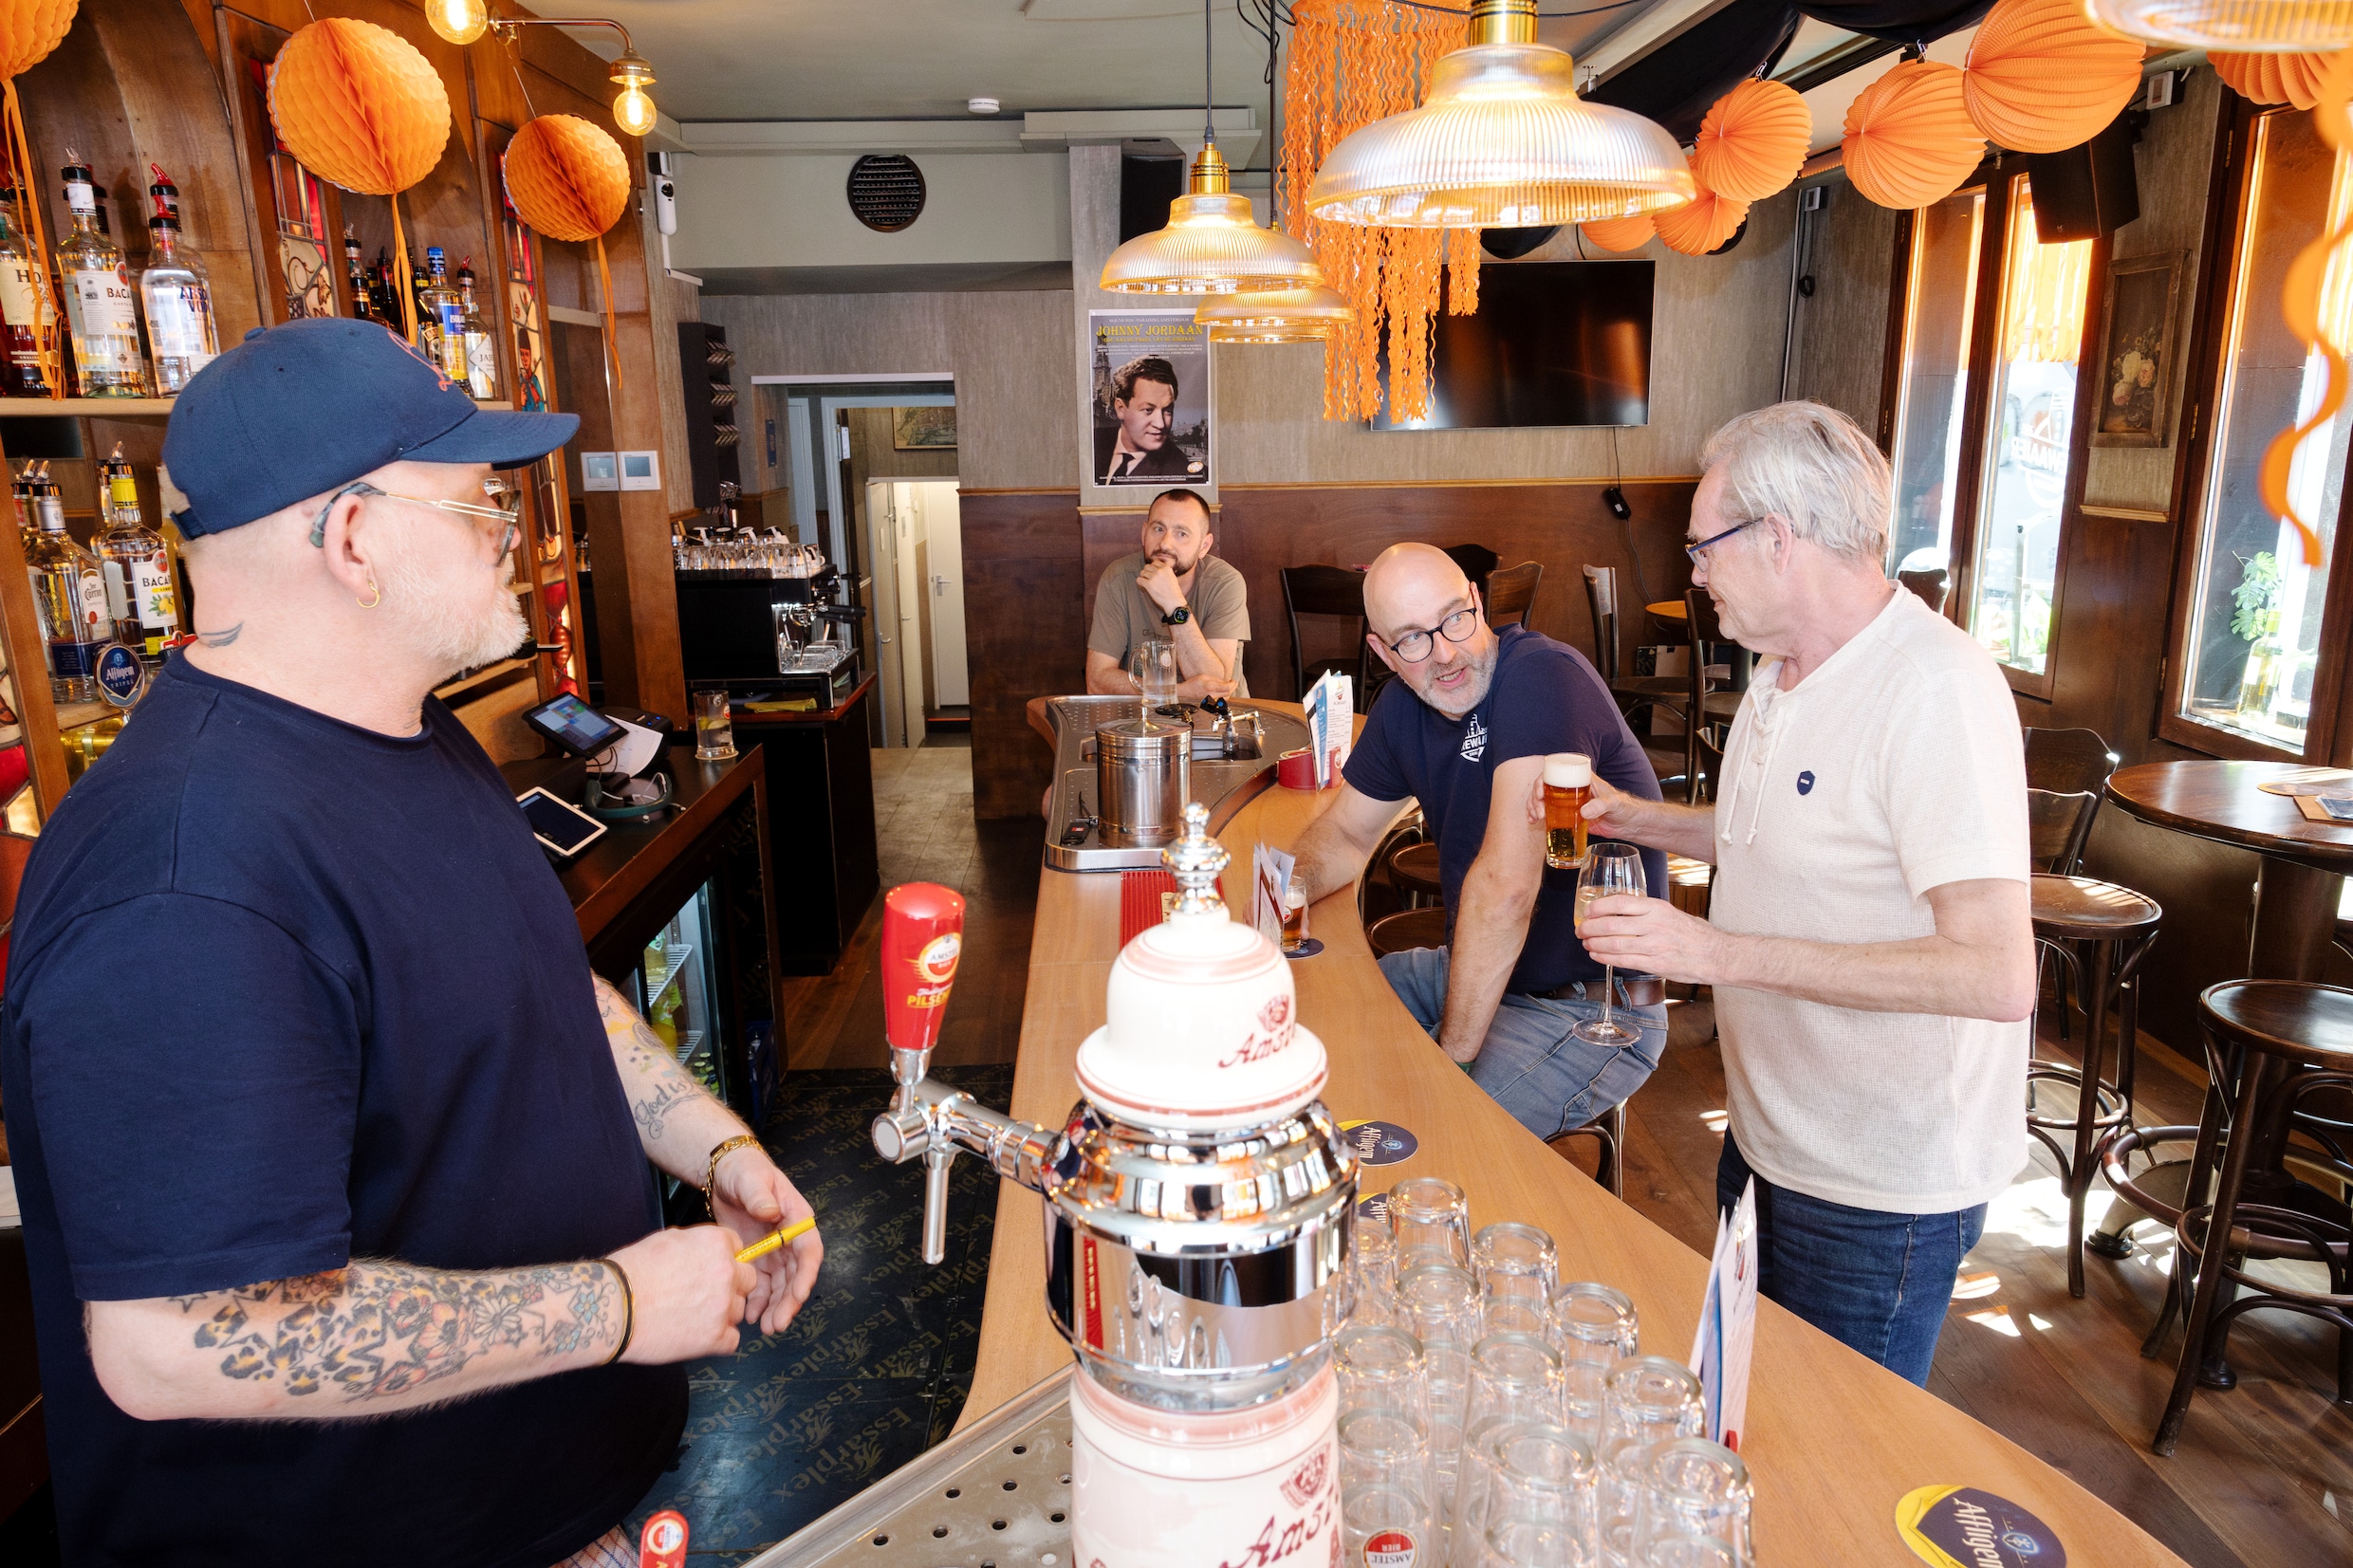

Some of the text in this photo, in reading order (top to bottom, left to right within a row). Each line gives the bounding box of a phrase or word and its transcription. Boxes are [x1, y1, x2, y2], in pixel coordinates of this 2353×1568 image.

[106, 287, 131, 299] BACA
[179, 286, 207, 300] ABSO
[1096, 323, 1203, 337] JOHNNY JORDAAN
[142, 577, 171, 587] BACA
[105, 666, 135, 681] Affligem
[110, 680, 135, 689] TRIPEL
[1356, 1126, 1381, 1159] Affligem
[734, 1289, 854, 1362] Essarlex
[771, 1309, 897, 1386] Essarplex
[772, 1407, 912, 1503] Essarplex
[1381, 1543, 1401, 1552] BIER
[1371, 1552, 1412, 1563] AMSTEL
